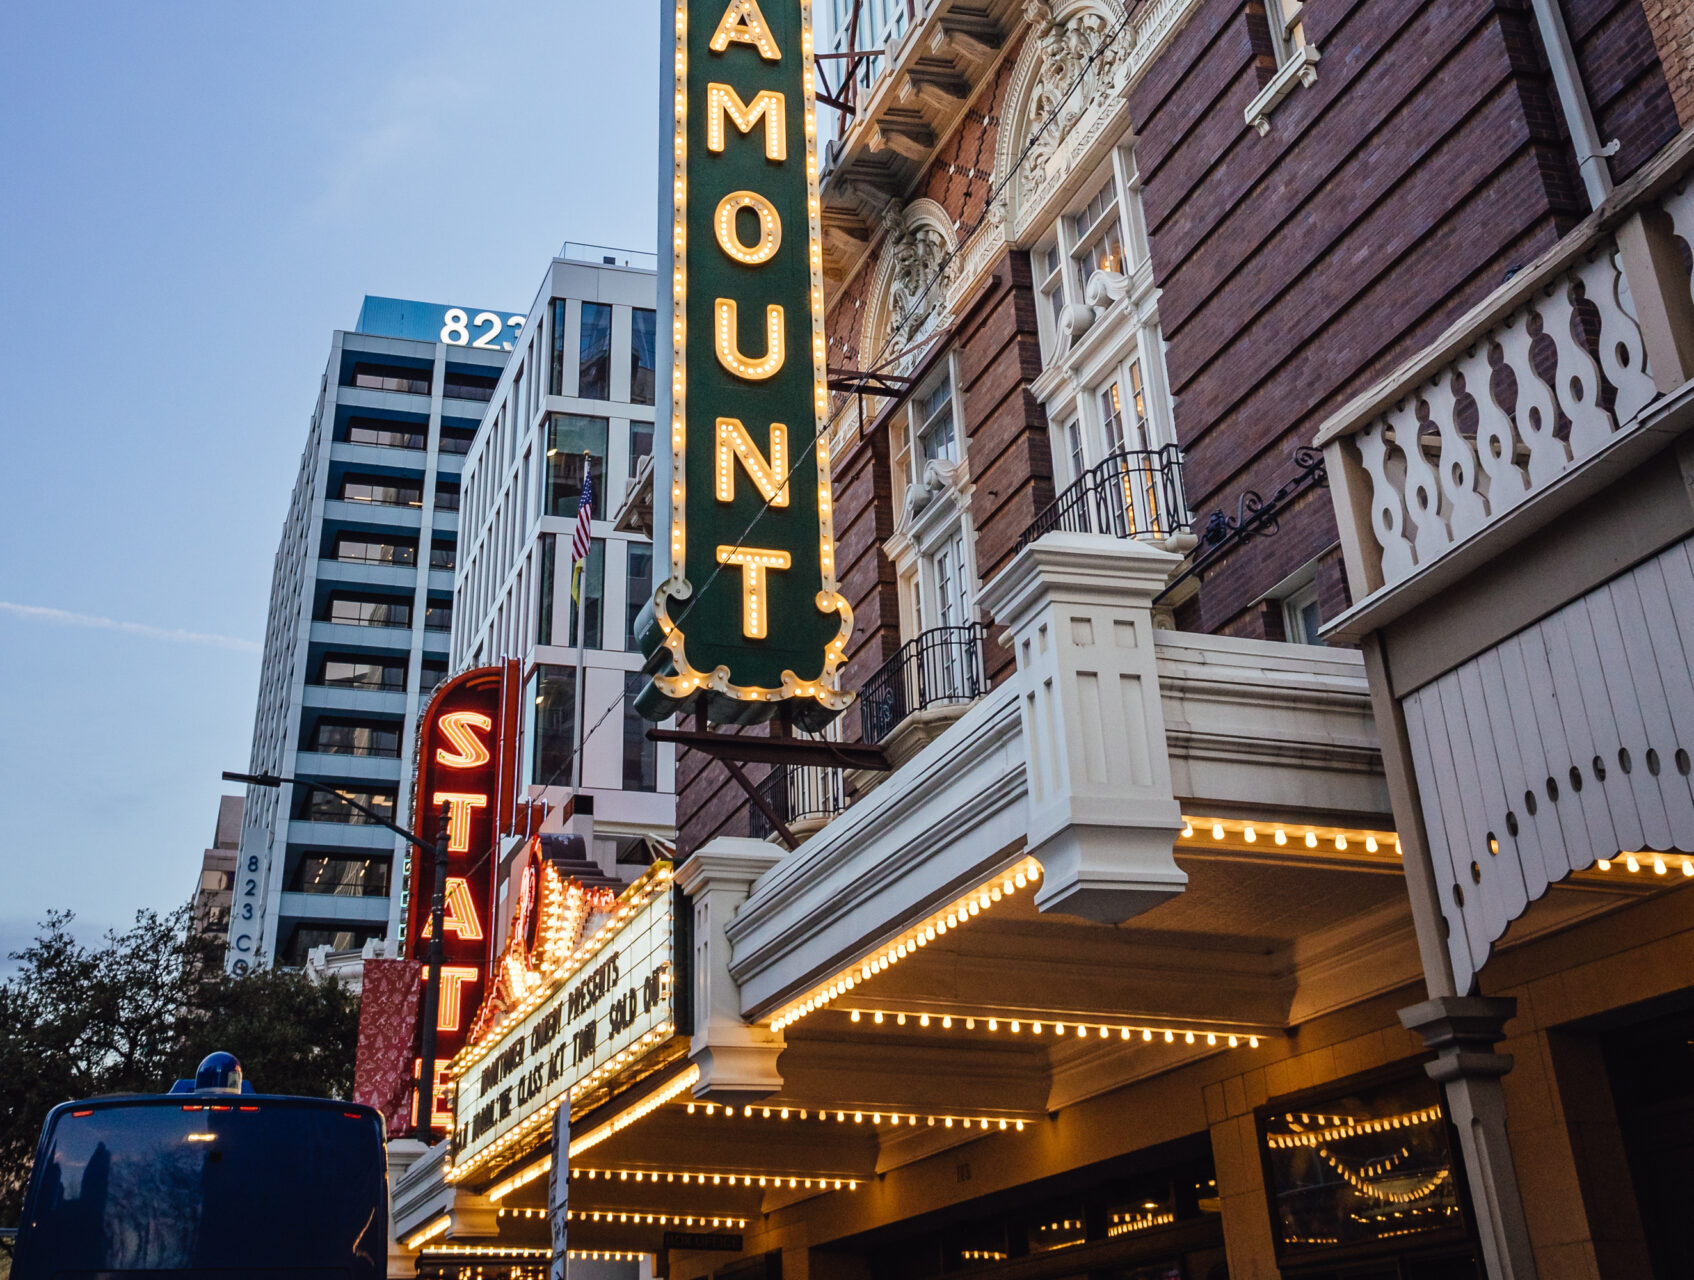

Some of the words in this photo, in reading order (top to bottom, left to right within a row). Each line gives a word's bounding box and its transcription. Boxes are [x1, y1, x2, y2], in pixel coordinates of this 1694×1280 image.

[440, 308, 527, 351] 823
[242, 855, 259, 920] 823
[411, 711, 492, 1128] STATE
[567, 951, 619, 1026] PRESENTS
[517, 1061, 544, 1108] CLASS
[547, 1041, 566, 1088] ACT
[608, 987, 638, 1040] SOLD
